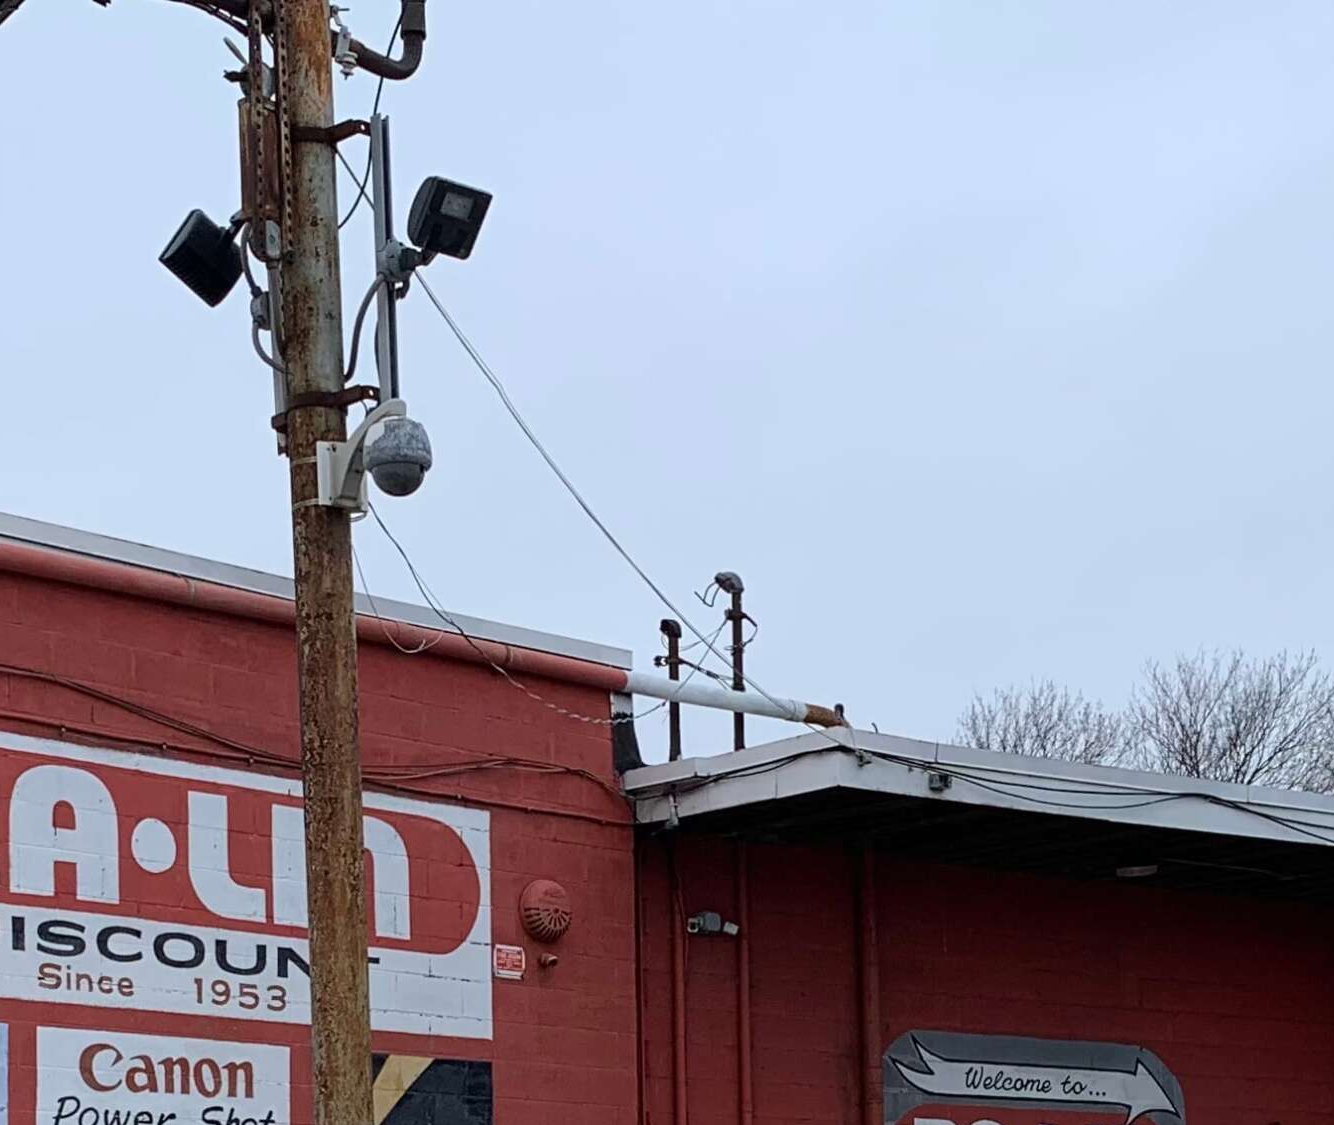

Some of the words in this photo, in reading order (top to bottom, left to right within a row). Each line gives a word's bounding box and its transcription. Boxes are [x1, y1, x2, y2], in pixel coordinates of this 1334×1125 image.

[36, 962, 136, 997] Since
[192, 976, 288, 1012] 1953
[79, 1042, 255, 1099] Canon
[965, 1066, 1052, 1094] Welcome
